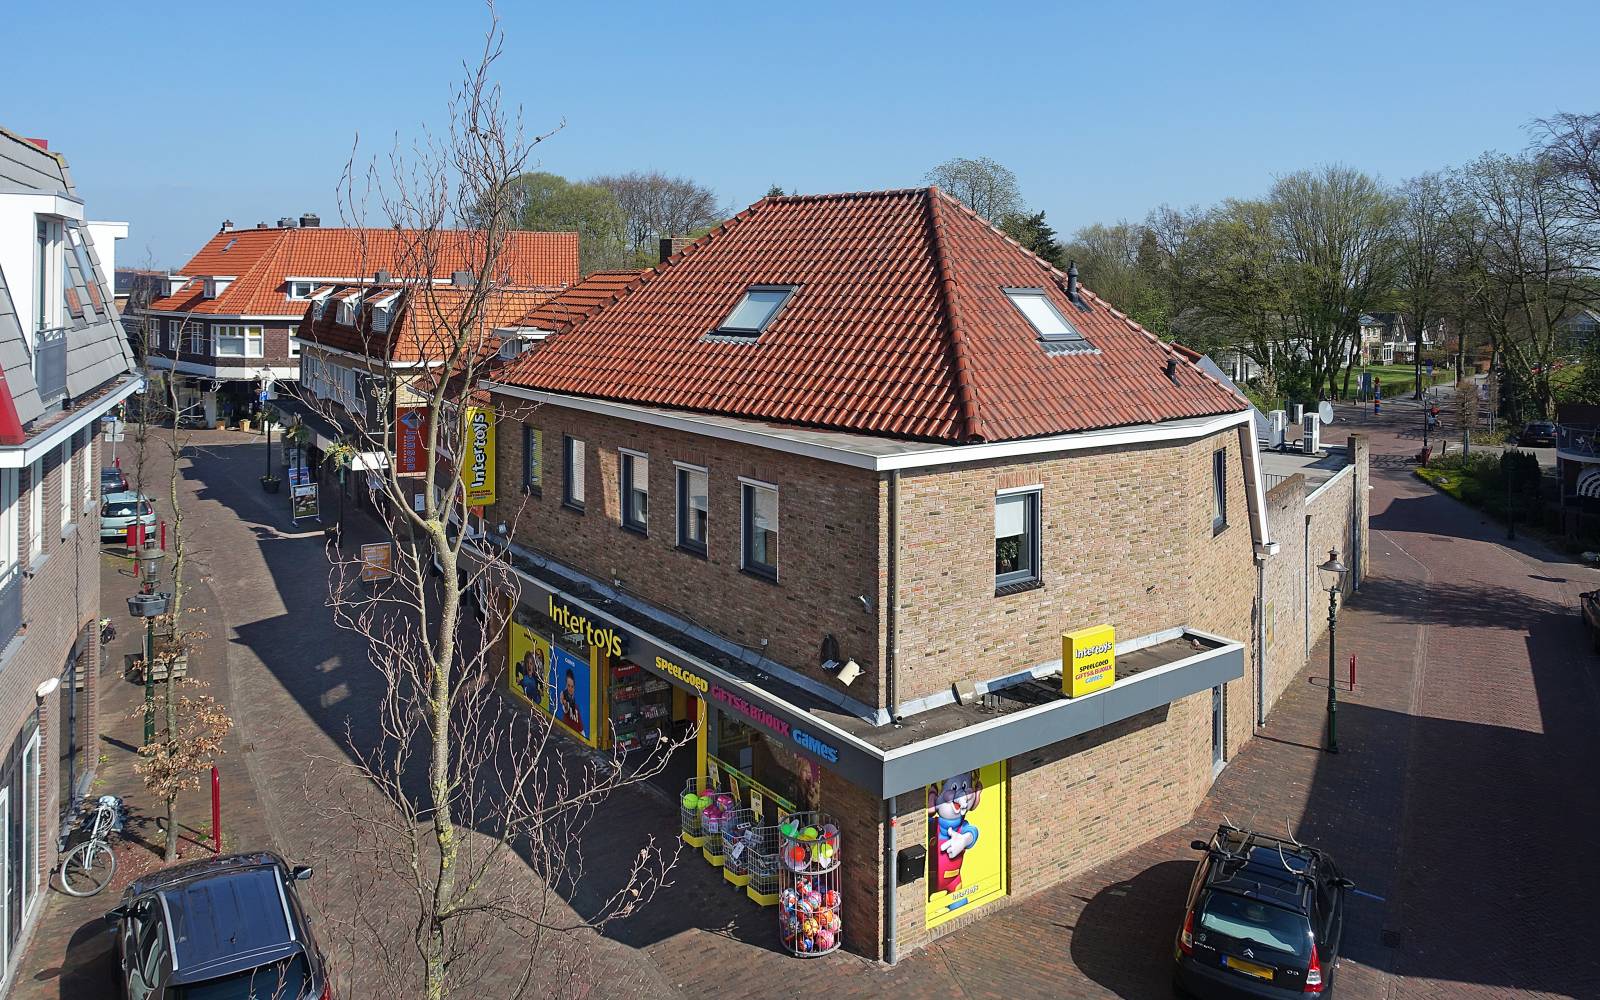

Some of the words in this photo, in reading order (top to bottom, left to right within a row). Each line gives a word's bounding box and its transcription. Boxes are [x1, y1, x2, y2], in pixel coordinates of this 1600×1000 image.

[405, 429, 417, 471] Jansen
[470, 412, 489, 489] Intertoys
[548, 594, 622, 658] Intertoys
[1075, 641, 1112, 659] Intertoys
